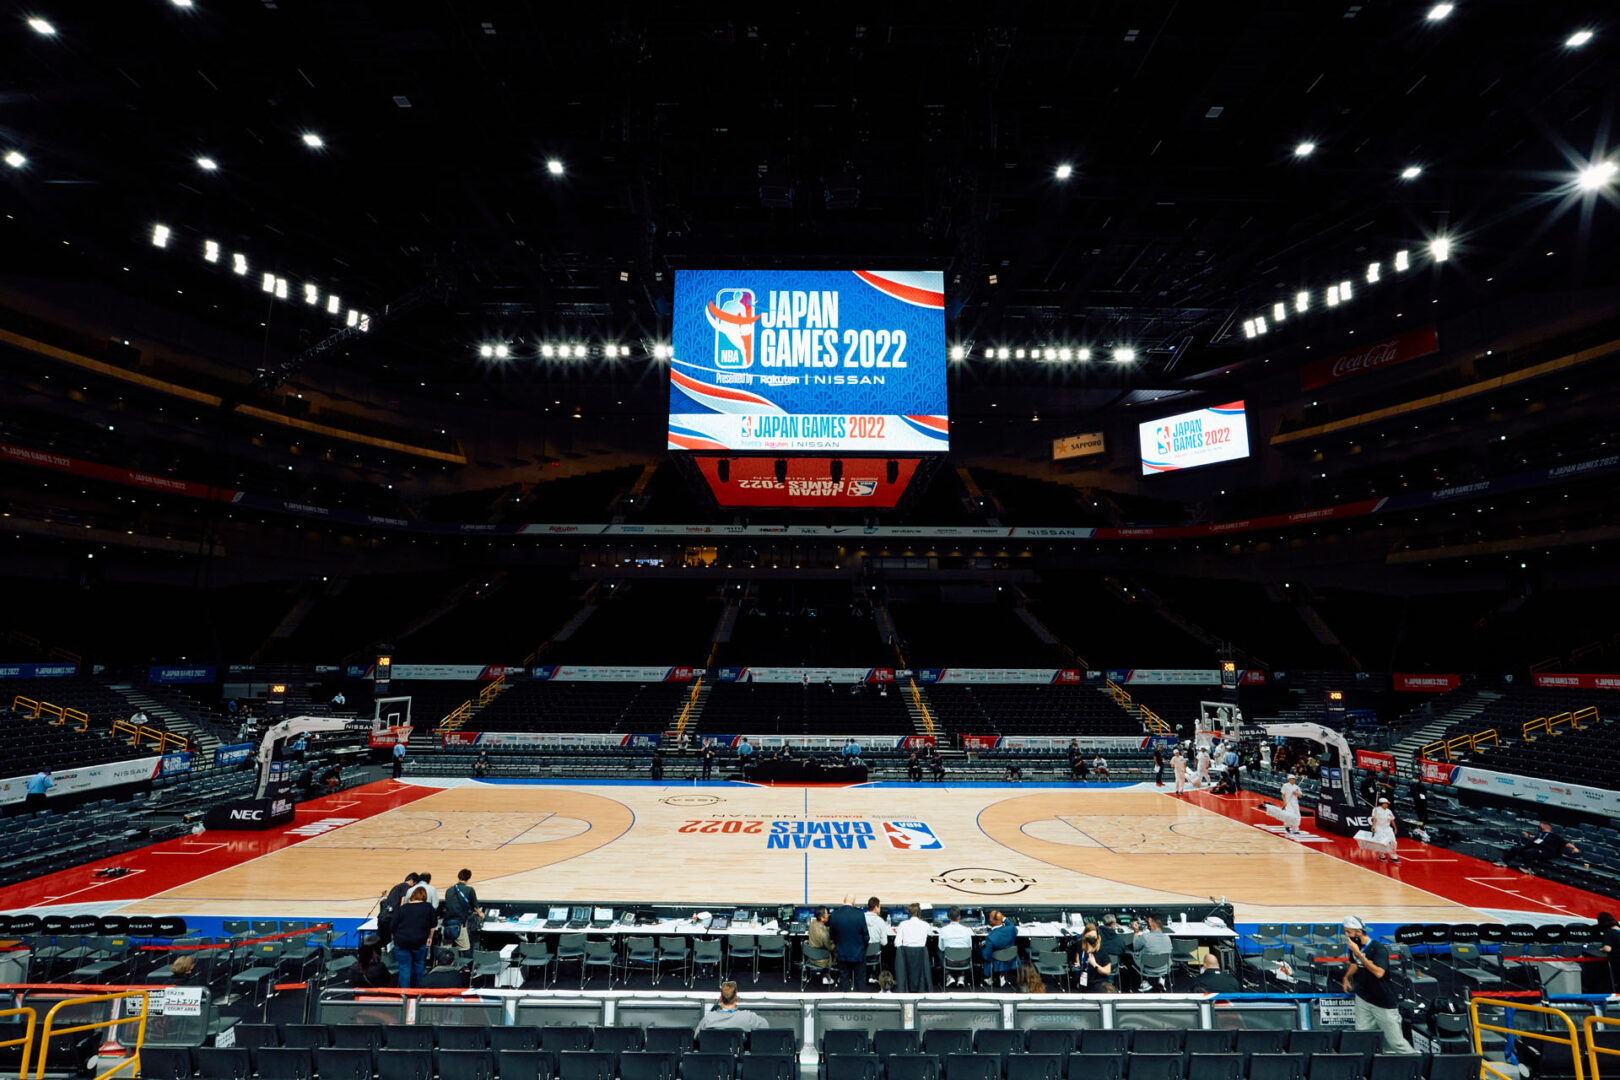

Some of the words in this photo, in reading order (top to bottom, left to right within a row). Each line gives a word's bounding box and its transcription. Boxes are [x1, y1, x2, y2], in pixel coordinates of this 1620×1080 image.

[761, 291, 838, 328] JAPAN
[760, 329, 838, 367] GAMES
[843, 329, 907, 368] 2022
[721, 350, 739, 363] NBA
[760, 375, 800, 387] Rakuten
[815, 376, 885, 384] NISSAN
[754, 416, 798, 438] JAPAN
[802, 416, 846, 438] GAMES
[849, 416, 885, 438] 2022
[1172, 418, 1202, 438] JAPAN
[1071, 440, 1102, 450] SAPPORO
[1173, 433, 1203, 452] GAMES
[1204, 427, 1231, 446] 2022
[738, 480, 785, 489] 2022
[788, 481, 845, 490] GAMES
[788, 488, 843, 496] JAPAN
[114, 768, 148, 778] NISSAN
[229, 809, 265, 821] NEC
[678, 820, 764, 834] 2022
[770, 821, 873, 835] GAMES
[767, 834, 876, 849] JAPAN
